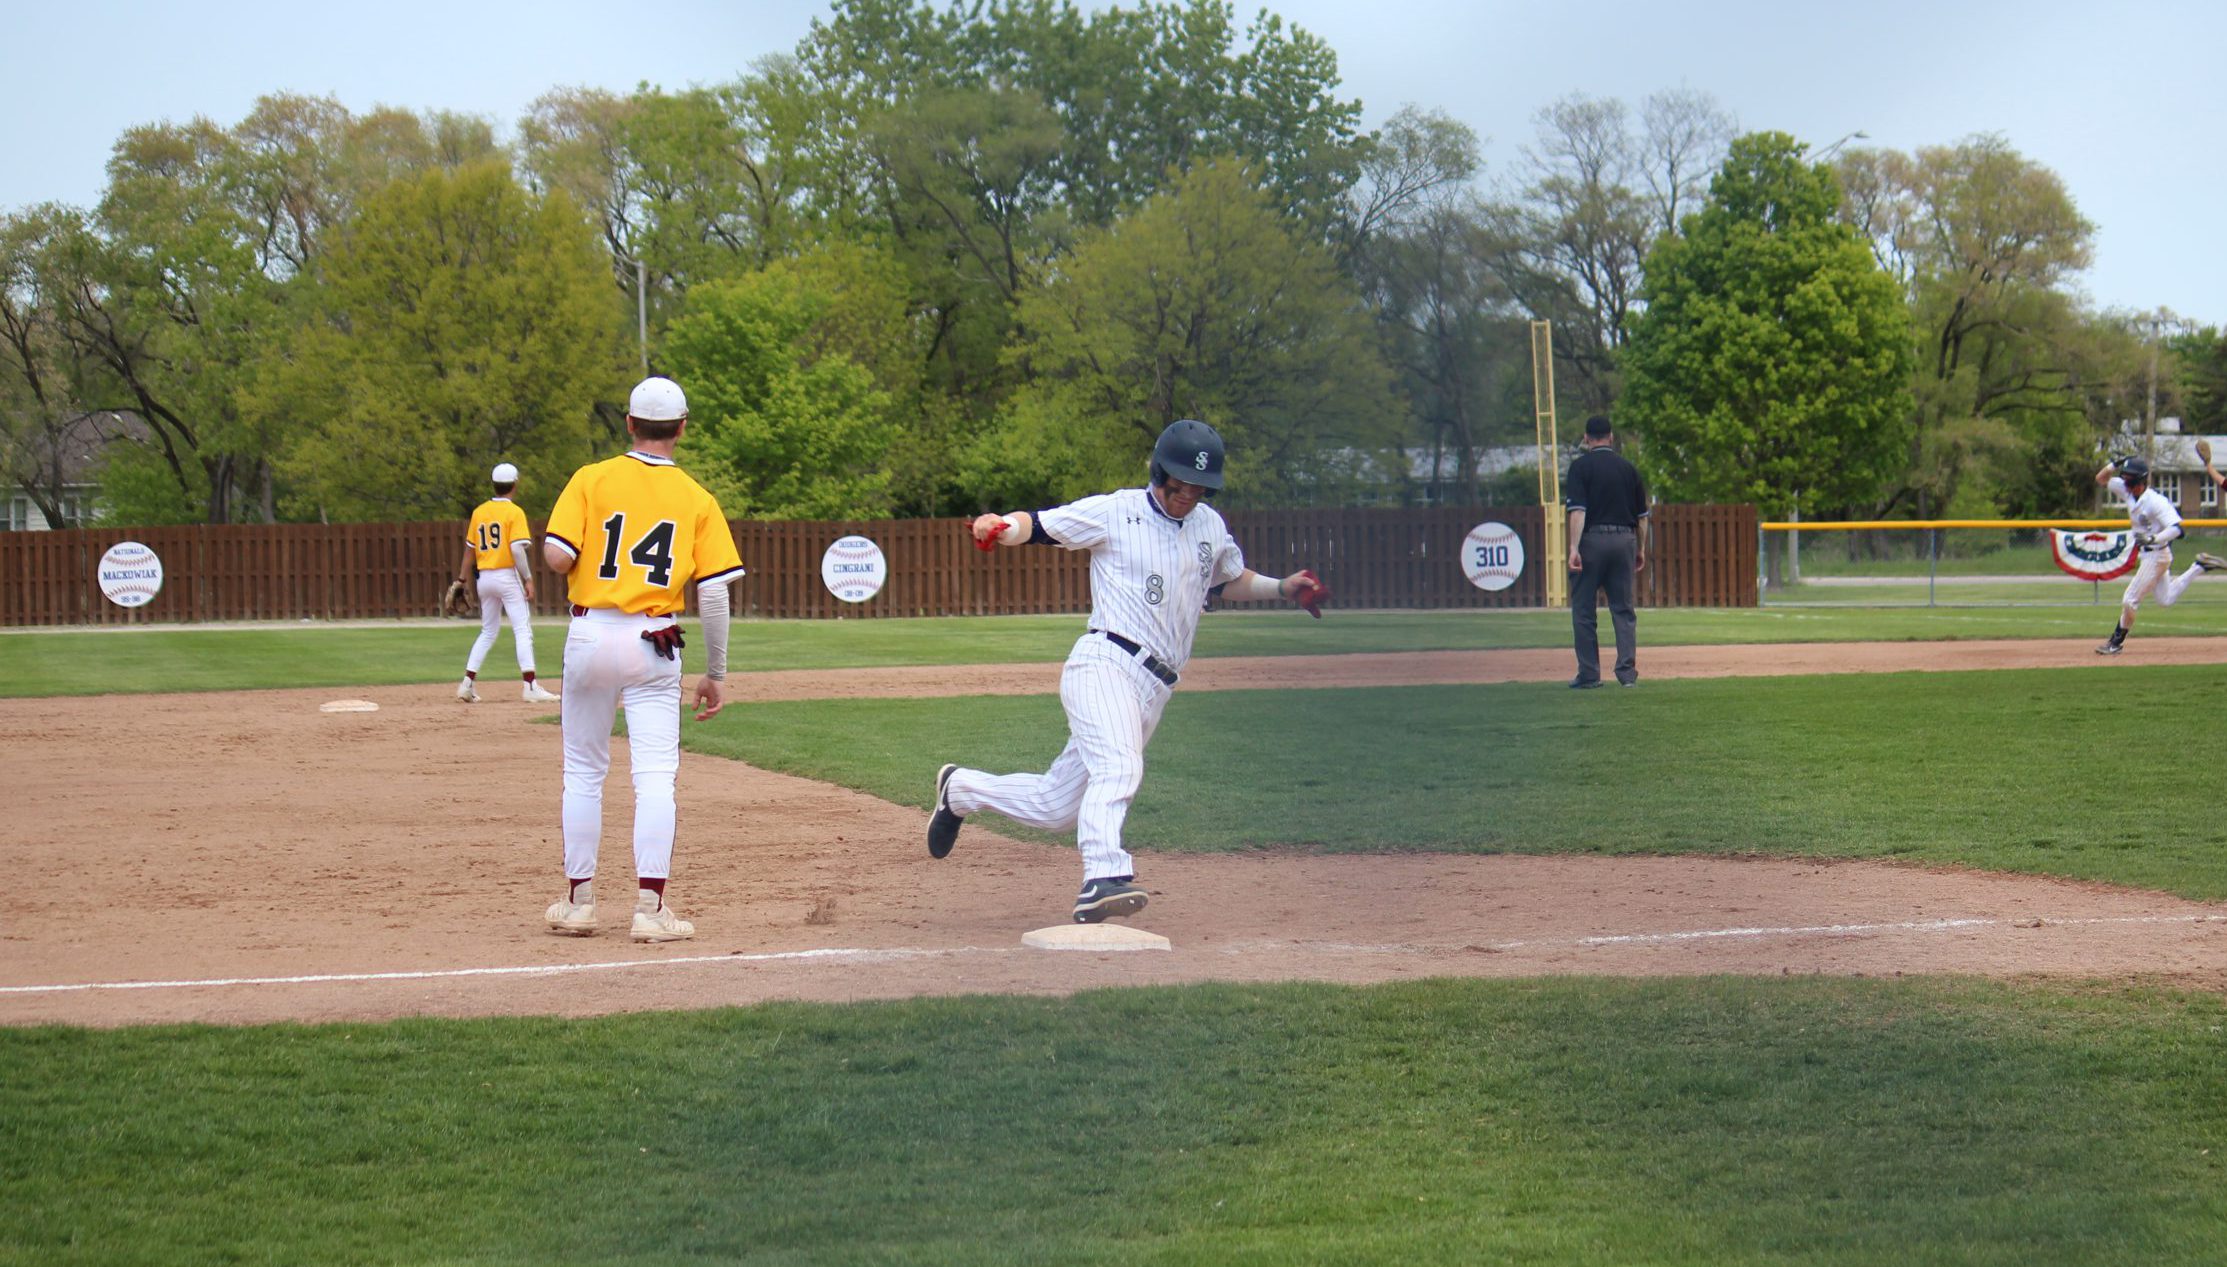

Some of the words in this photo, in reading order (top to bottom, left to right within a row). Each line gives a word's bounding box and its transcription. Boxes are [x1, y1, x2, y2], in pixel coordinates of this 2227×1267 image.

[477, 521, 502, 551] 19
[597, 512, 676, 588] 14
[1475, 545, 1509, 568] 310
[103, 569, 157, 580] MACKOWIAK
[832, 563, 874, 573] CINGRANI
[1144, 573, 1164, 605] 8
